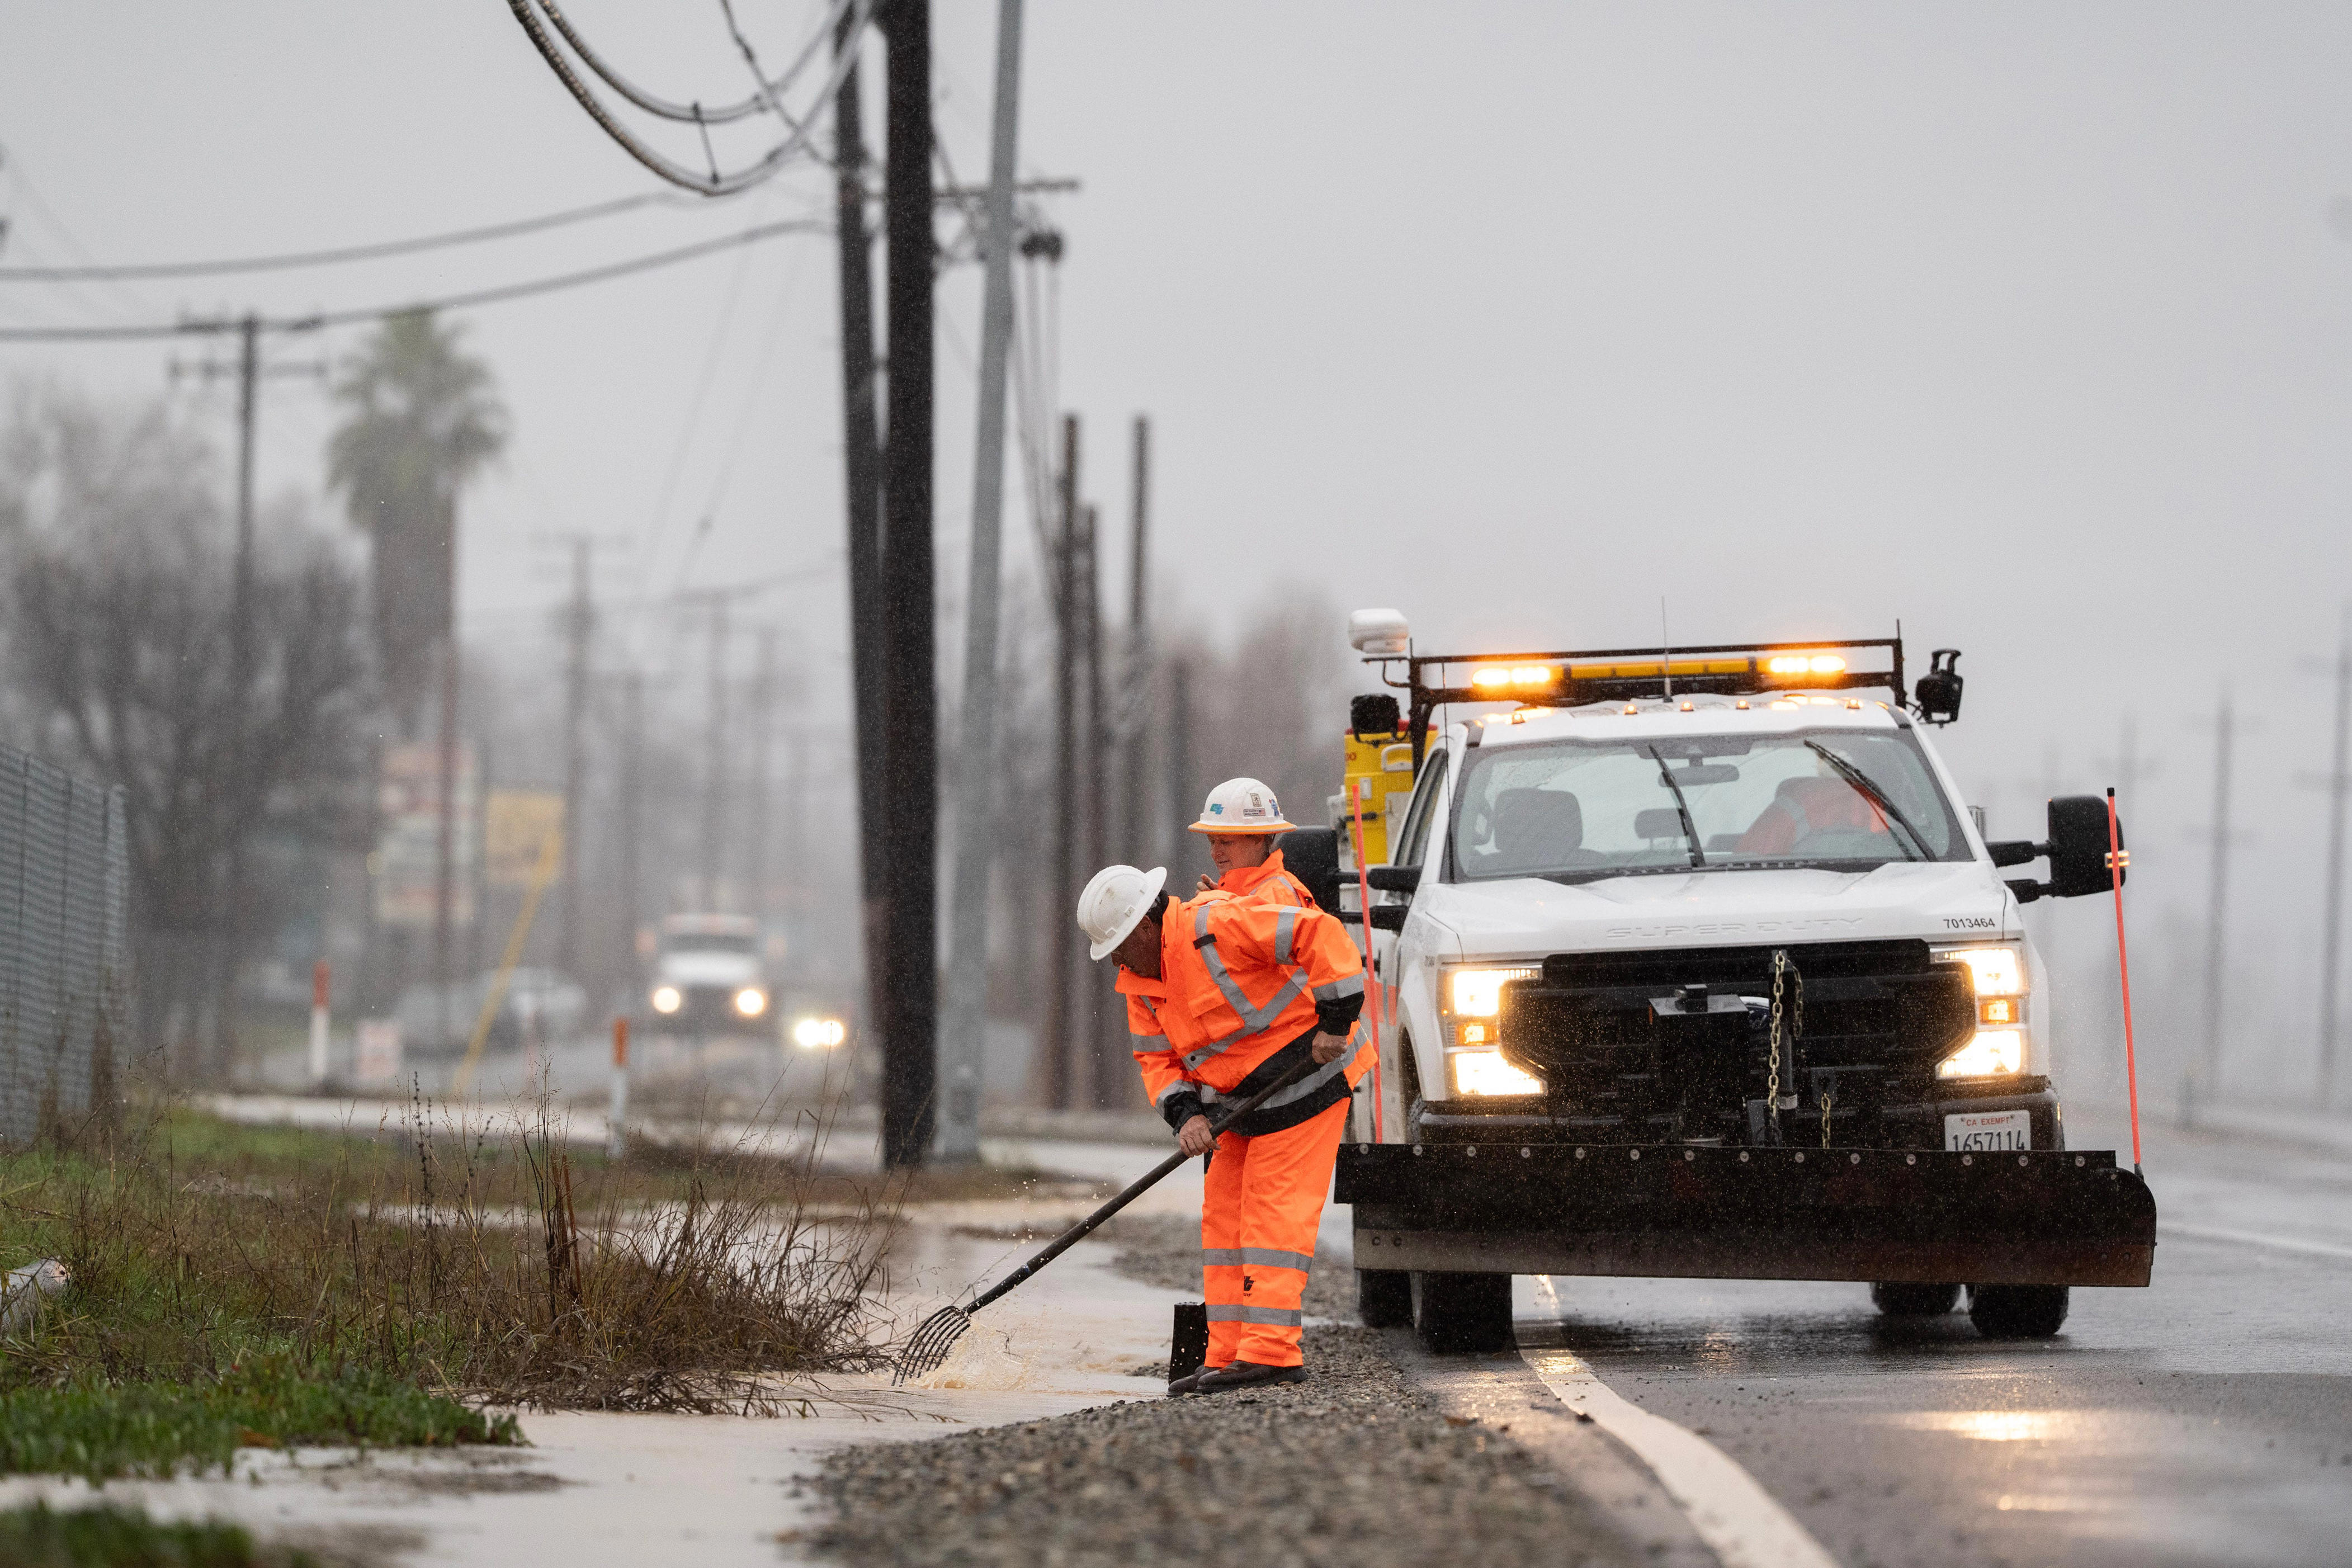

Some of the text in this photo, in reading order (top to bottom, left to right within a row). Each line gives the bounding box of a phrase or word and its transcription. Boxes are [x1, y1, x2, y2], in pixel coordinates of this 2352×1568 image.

[1607, 917, 1863, 938] SUPER DUTY
[1943, 918, 1995, 928] 7013464
[1981, 1117, 2009, 1126] EXEMPT
[1952, 1130, 2025, 1151] 1657114
